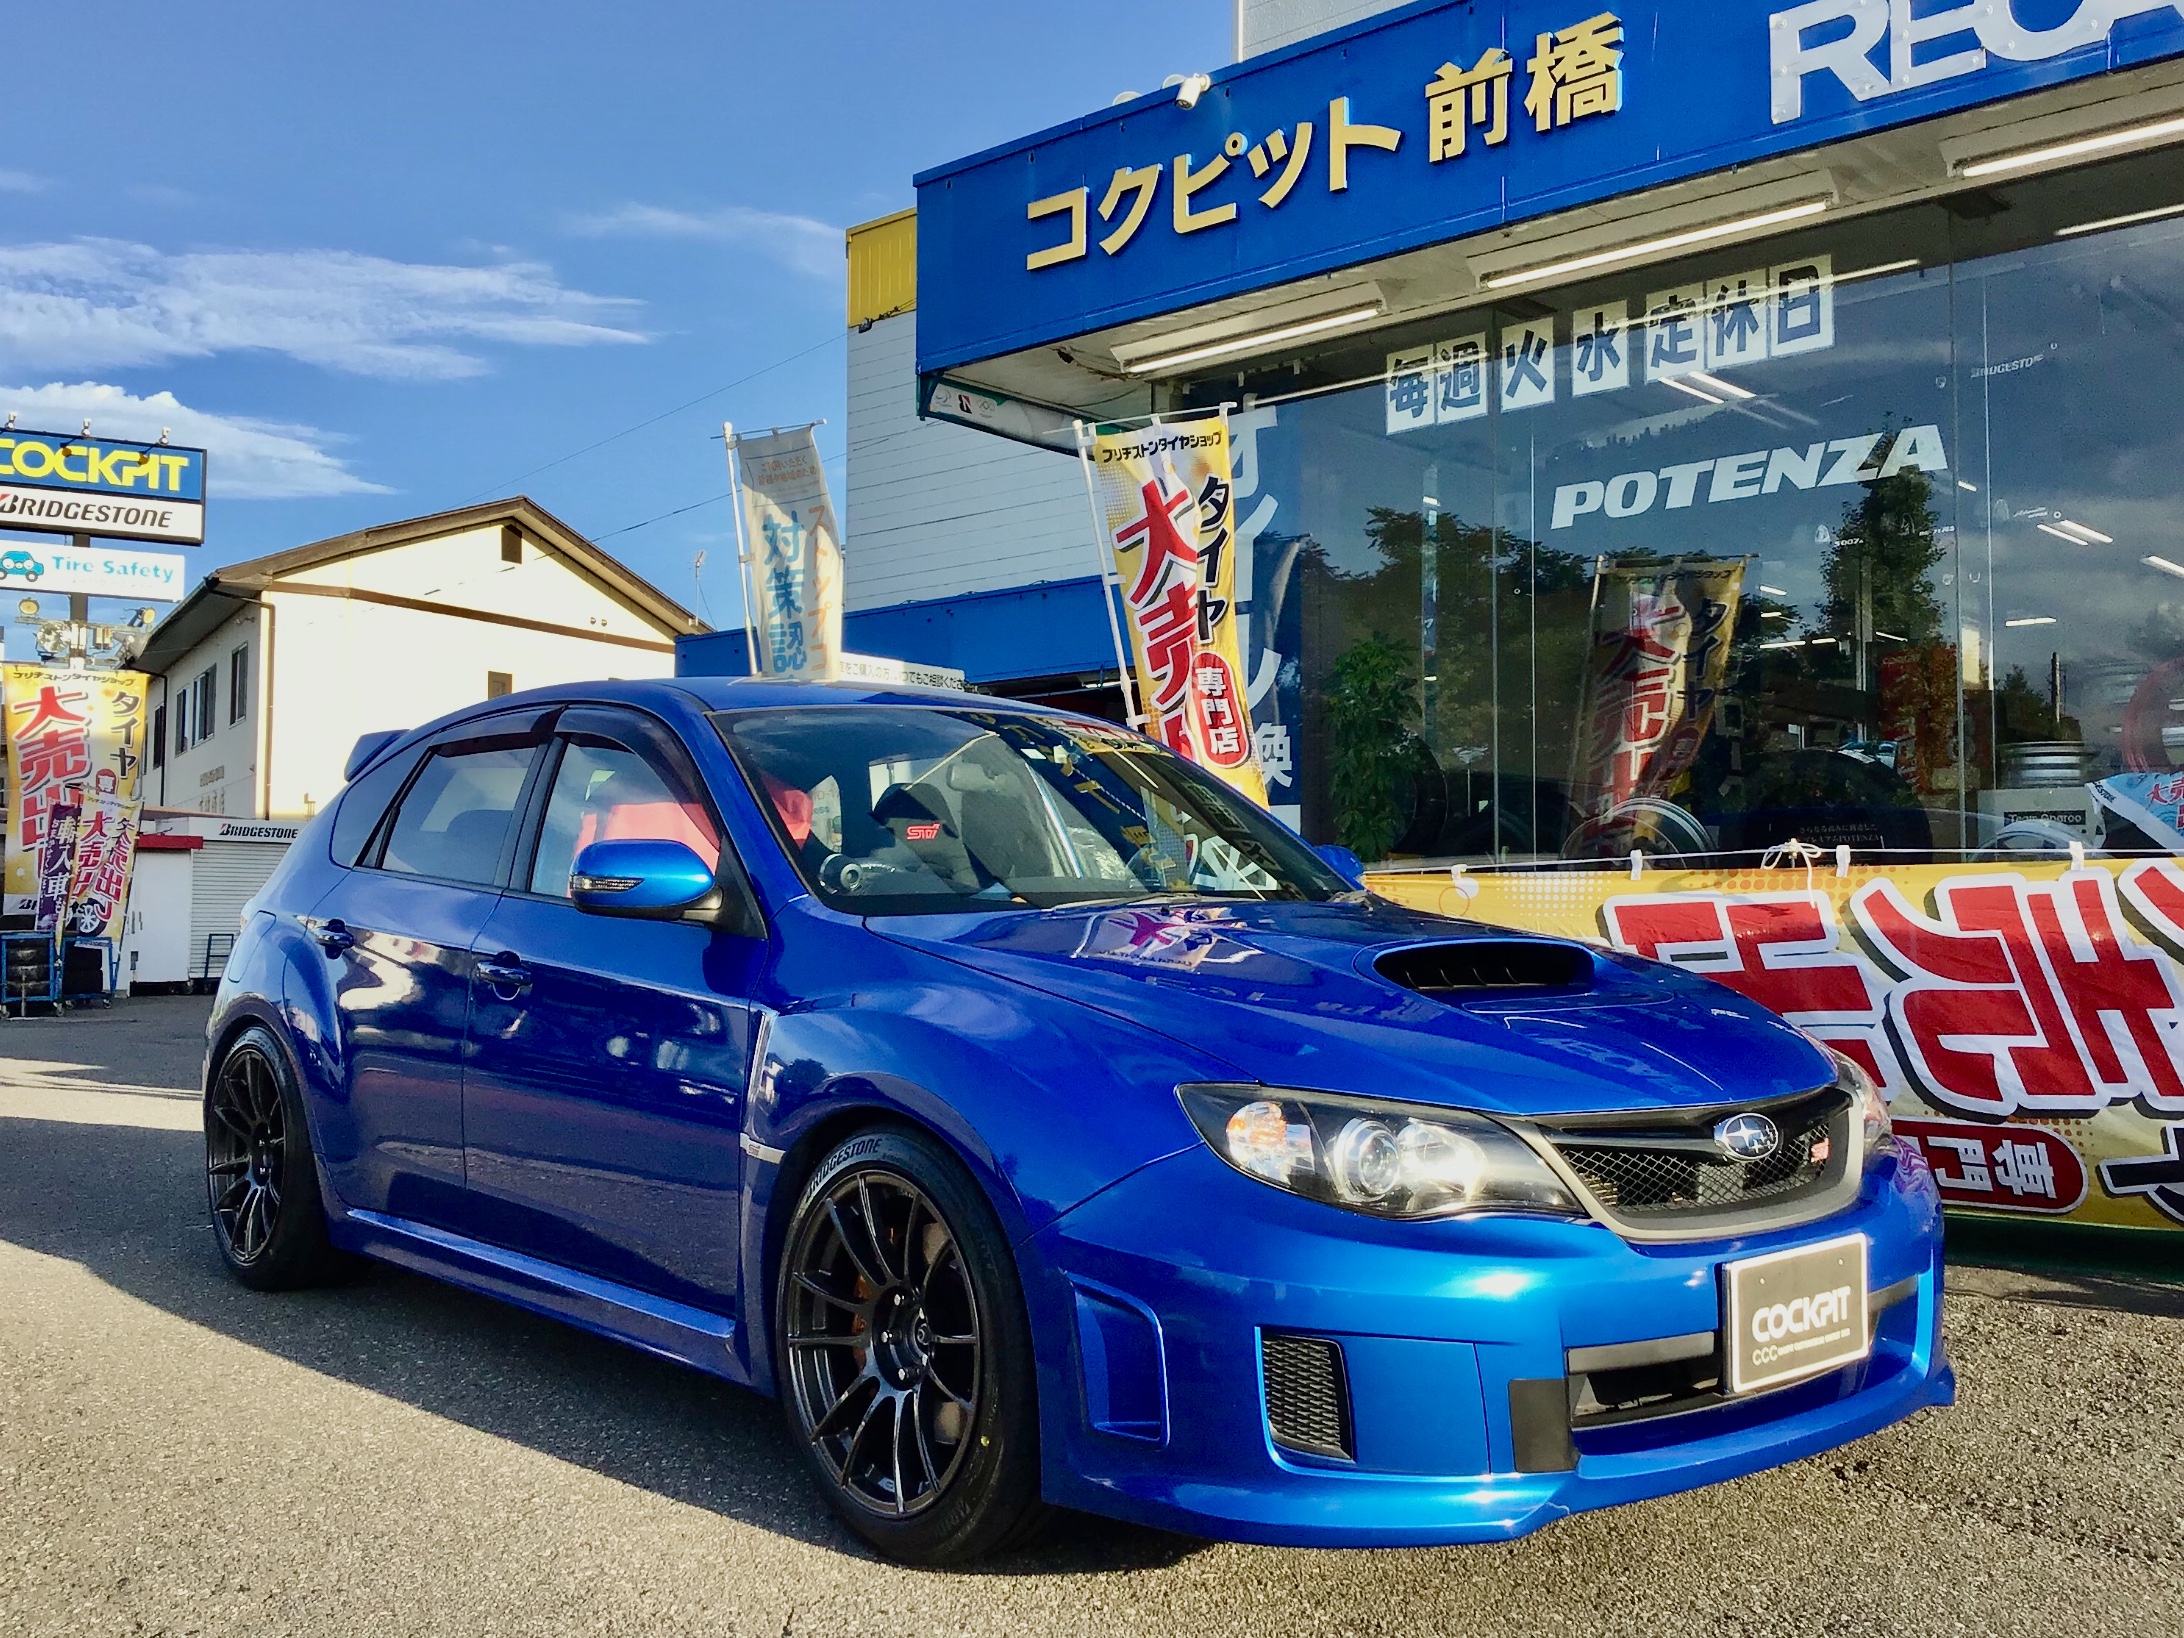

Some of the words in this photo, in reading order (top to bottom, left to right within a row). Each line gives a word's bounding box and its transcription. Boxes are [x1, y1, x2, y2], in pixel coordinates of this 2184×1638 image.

[1026, 97, 1402, 271] コクピット
[1424, 11, 1625, 164] 前橋
[1388, 263, 1823, 420] 毎週火水定休日
[0, 493, 173, 529] BRIDGESTONE
[1551, 424, 1948, 529] POTENZA
[52, 555, 95, 573] Tire
[103, 560, 174, 584] Safety
[1114, 478, 1200, 760] 大売
[110, 691, 140, 778] タイヤ
[1194, 667, 1240, 755] 専門店
[13, 686, 86, 880] 大売出
[219, 823, 299, 839] BRIDGESTONE
[1892, 1134, 2057, 1199] 専門
[1751, 1285, 1851, 1343] COCKPIT
[1752, 1344, 1778, 1366] CCC
